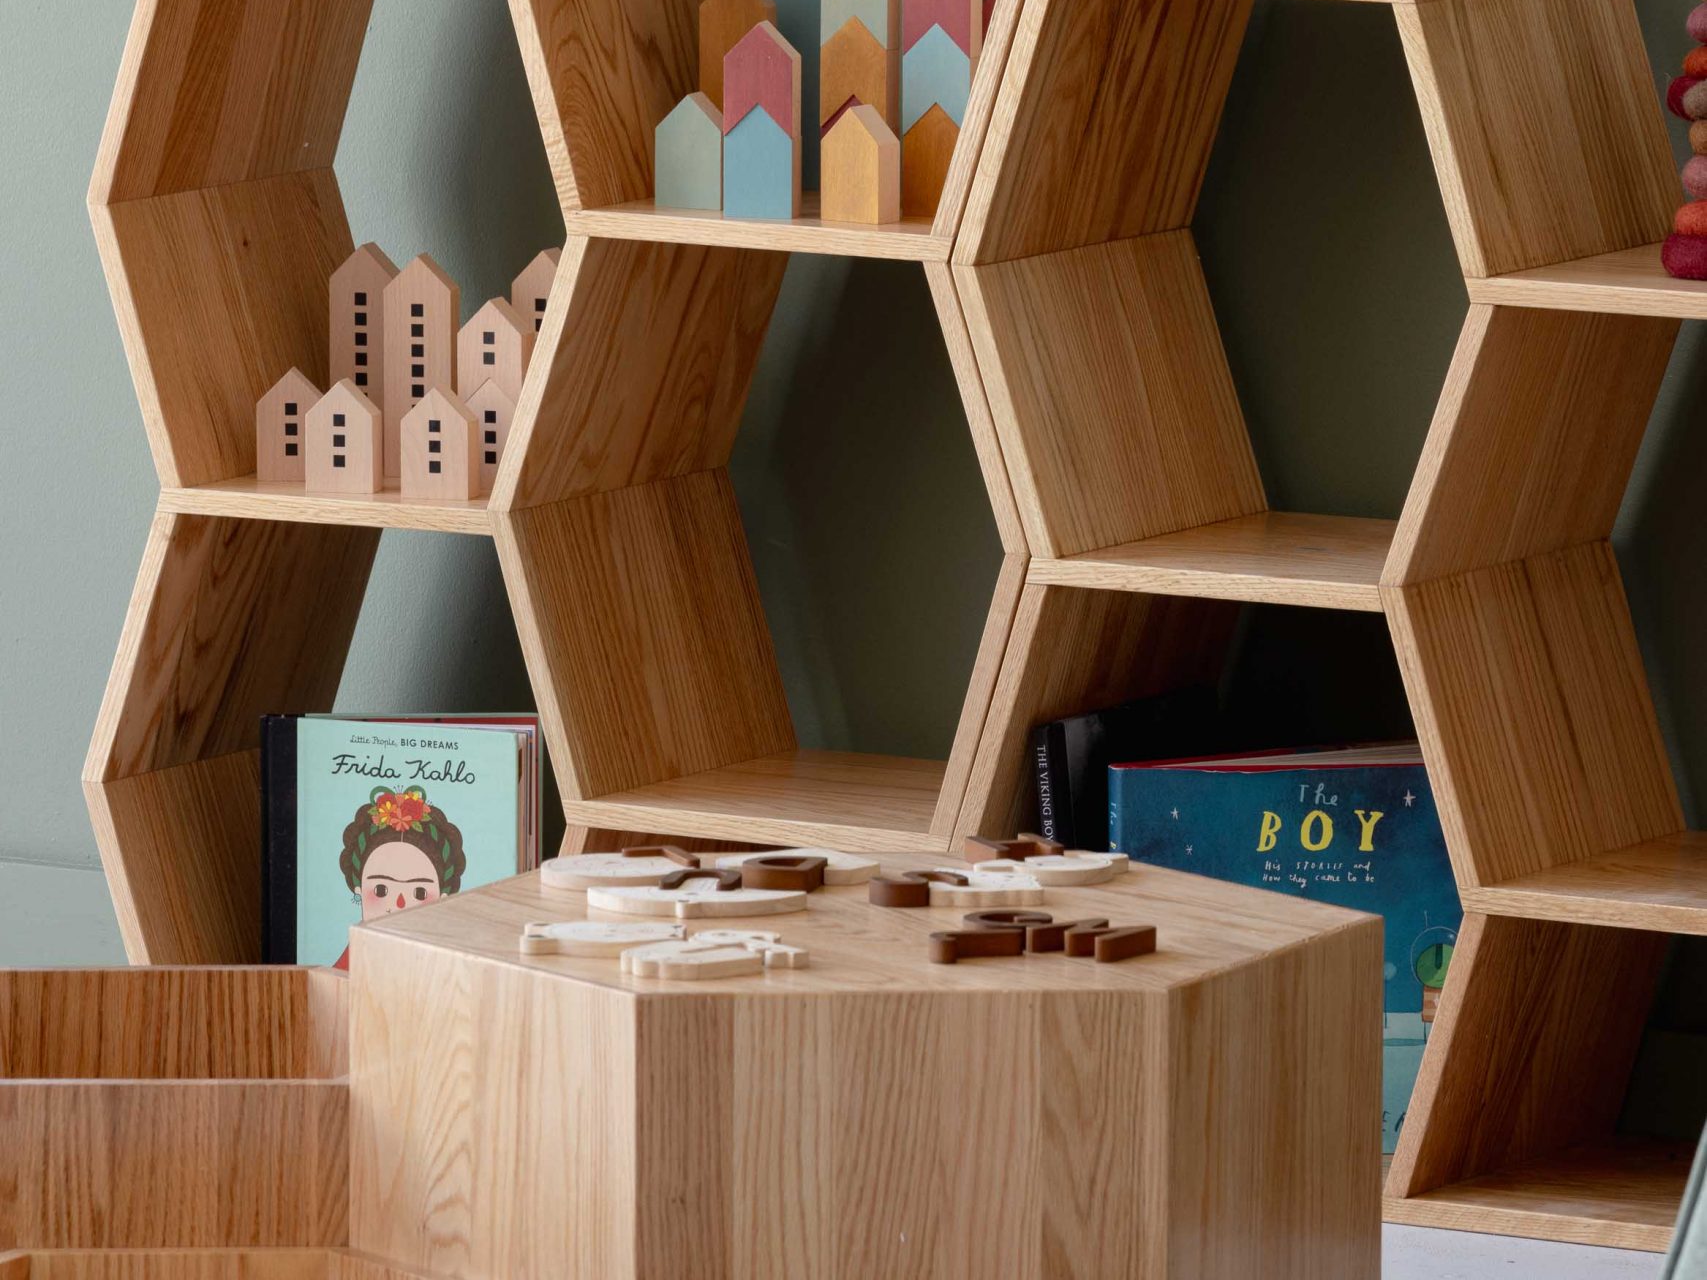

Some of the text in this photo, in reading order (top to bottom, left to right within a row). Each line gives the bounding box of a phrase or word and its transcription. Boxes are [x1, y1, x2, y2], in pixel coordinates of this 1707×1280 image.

[350, 734, 371, 745] Little
[400, 738, 417, 748] BIG
[420, 740, 459, 751] DREAMS
[1037, 745, 1047, 769] THE
[331, 754, 476, 785] Frida Kahlo
[1040, 771, 1052, 816] VIKING
[1299, 782, 1338, 806] The
[1256, 809, 1384, 852] BOY
[1265, 859, 1371, 871] His STORIES and
[1262, 873, 1281, 881] How
[1289, 874, 1307, 888] they
[1347, 872, 1357, 882] to
[1365, 873, 1375, 883] be
